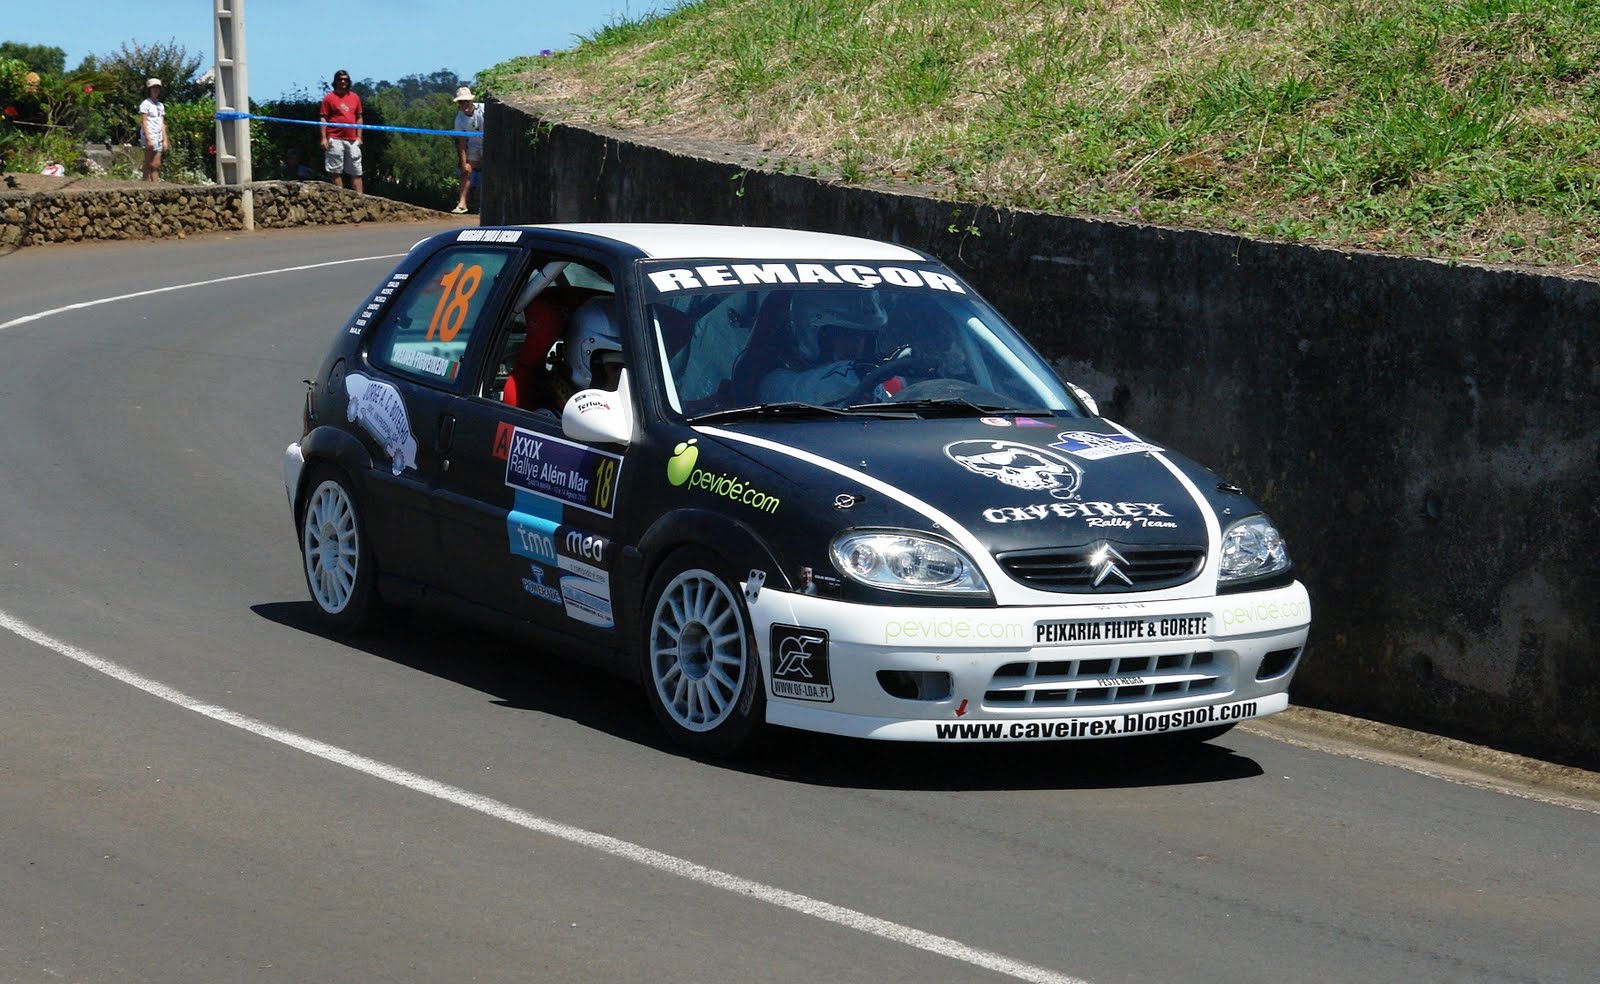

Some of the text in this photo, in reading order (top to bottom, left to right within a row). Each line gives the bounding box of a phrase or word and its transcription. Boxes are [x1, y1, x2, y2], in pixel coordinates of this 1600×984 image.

[648, 263, 967, 295] REMAÇOR
[426, 262, 483, 343] 18
[389, 400, 409, 445] BOTELHO
[496, 427, 509, 456] A
[513, 435, 543, 460] XXIX
[509, 454, 589, 493] Rallye Além Mar
[595, 458, 614, 508] 18
[688, 469, 780, 514] pevide.com
[982, 501, 1174, 524] CAVEIREX
[1086, 516, 1178, 530] Rally Team
[517, 523, 555, 559] tmn
[566, 530, 603, 562] meo
[885, 616, 1023, 644] pevide.com
[1037, 616, 1207, 643] PEIXARIA FILIPE & GORETE
[1222, 599, 1308, 632] pevide.com
[774, 680, 829, 698] WWW.QF-LDA.PT
[1097, 678, 1120, 687] PESTE
[936, 701, 1257, 740] www.caveirex.blogspot.com
